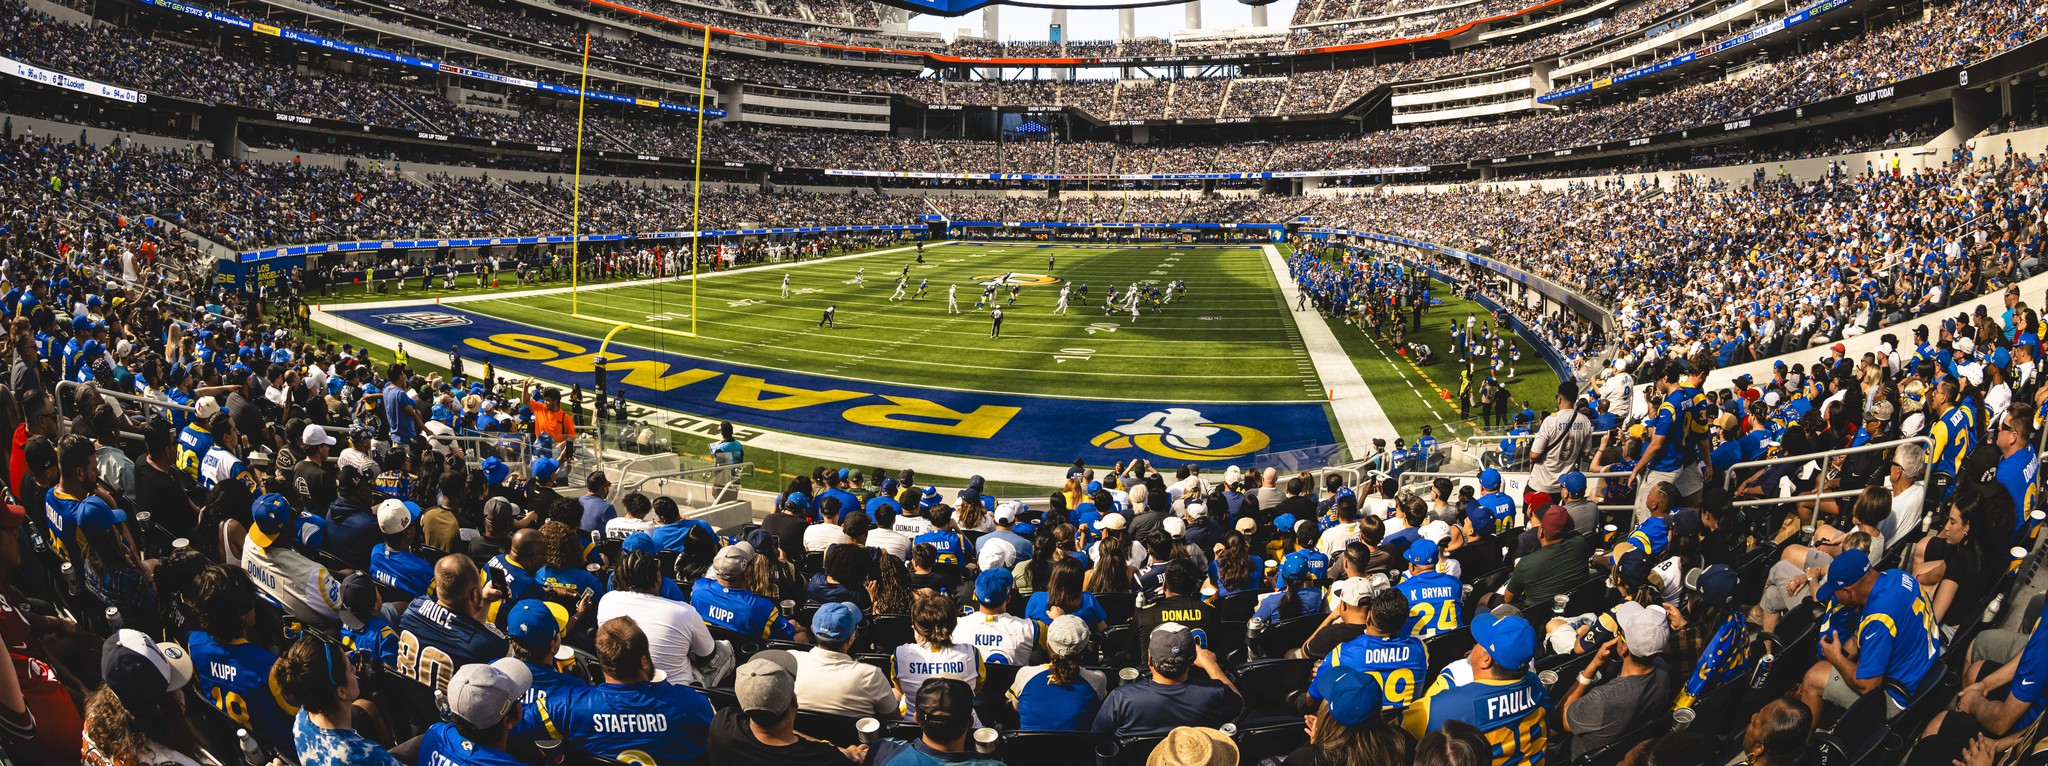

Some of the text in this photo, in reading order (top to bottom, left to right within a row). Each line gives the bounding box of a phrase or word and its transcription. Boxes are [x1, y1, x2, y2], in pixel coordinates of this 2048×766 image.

[185, 7, 203, 16] STATS
[1822, 2, 1832, 11] GEN
[285, 31, 297, 39] 3.04
[64, 77, 85, 89] T.Lockett
[1855, 86, 1894, 104] SIGN UP TODAY
[257, 264, 270, 272] LOS
[257, 280, 275, 289] RMS
[463, 333, 1022, 439] RAMS
[1510, 480, 1520, 490] 124
[1496, 504, 1510, 514] KUPP
[896, 524, 920, 534] DONALD
[928, 540, 950, 550] NALD
[247, 560, 276, 590] DONALD
[1411, 586, 1452, 601] K BRYANT
[418, 600, 458, 630] BRUCE
[710, 604, 734, 622] KUPP
[1162, 610, 1202, 622] DONALD
[1409, 600, 1457, 638] 24
[975, 634, 1004, 646] KUPP
[1365, 646, 1410, 664] DONALD
[210, 661, 237, 682] KUPP
[909, 662, 964, 675] STAFFORD
[1487, 686, 1536, 720] FAULK
[592, 714, 667, 733] STAFFORD
